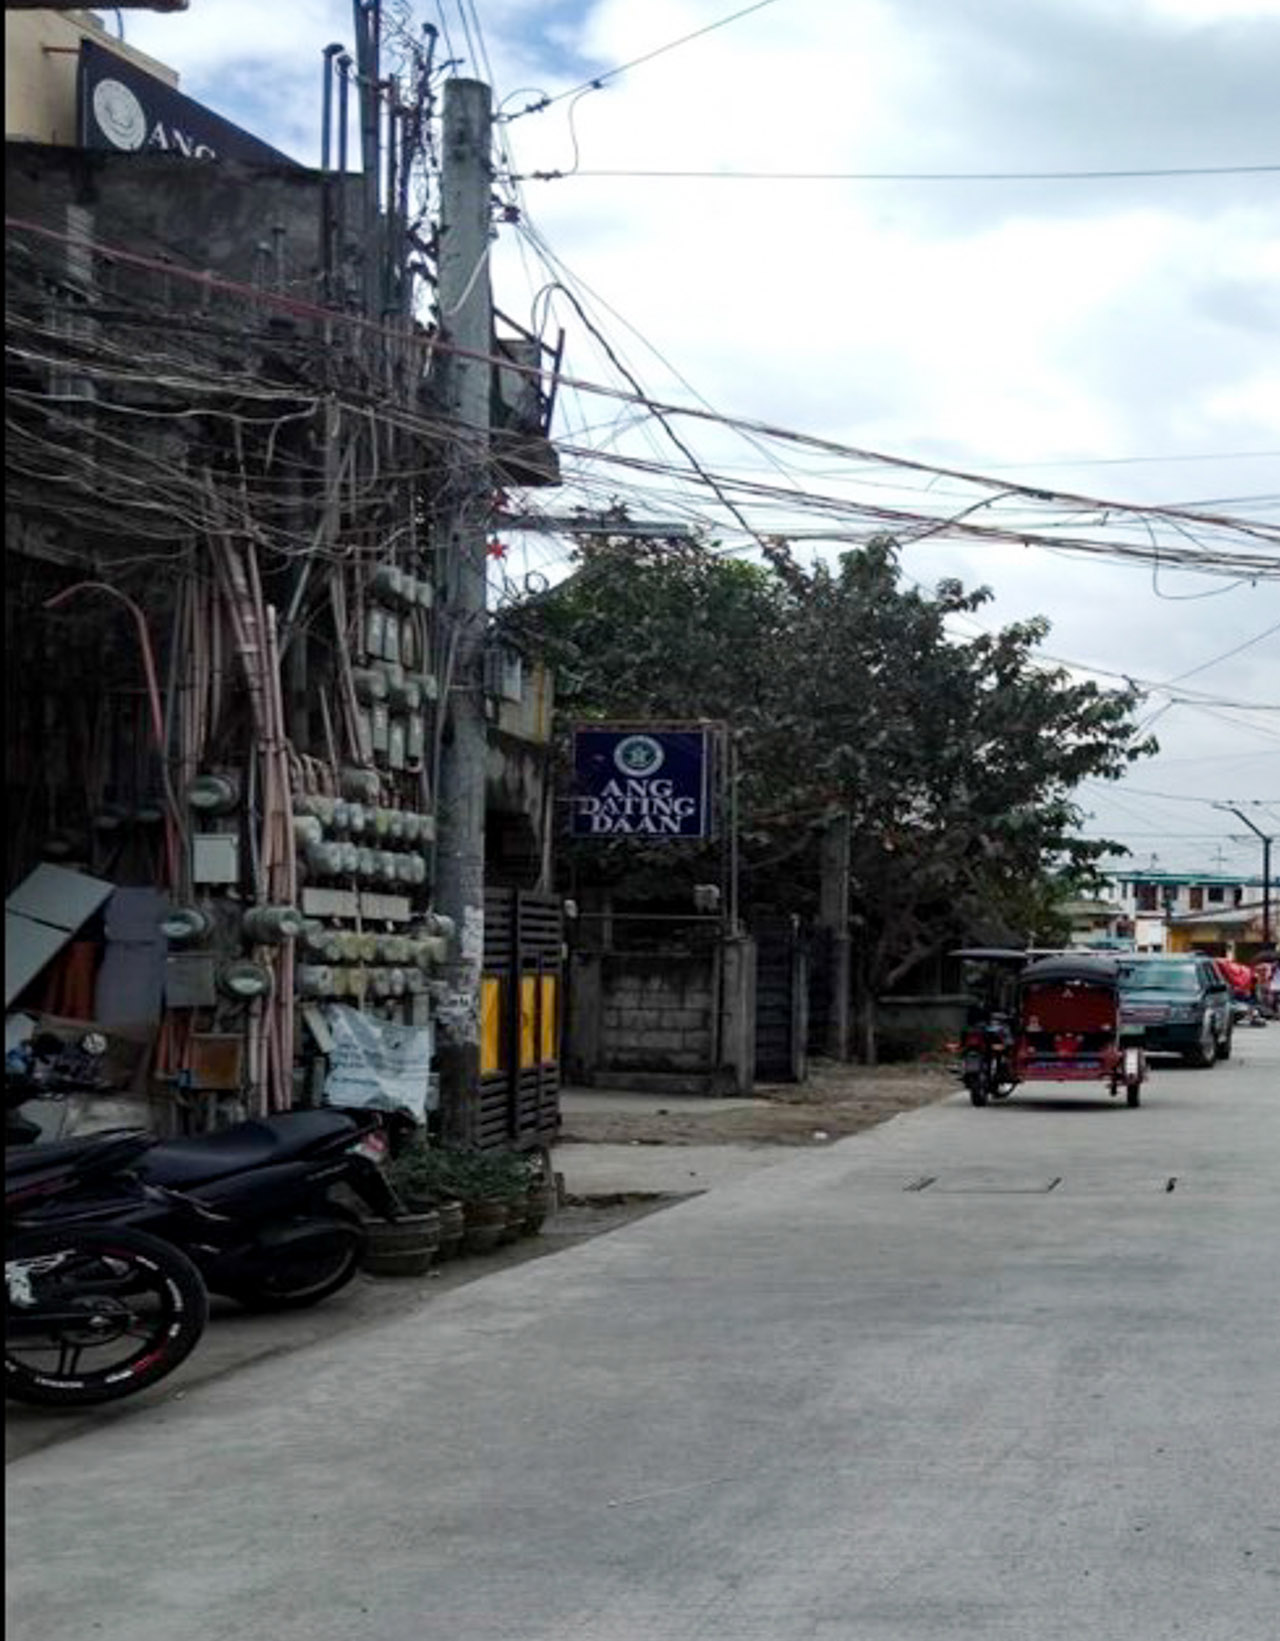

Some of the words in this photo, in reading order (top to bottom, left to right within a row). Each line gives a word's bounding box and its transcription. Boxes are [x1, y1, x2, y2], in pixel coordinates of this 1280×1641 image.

[600, 778, 674, 798] ANG
[579, 797, 696, 816] DATING
[591, 815, 682, 833] DAAN
